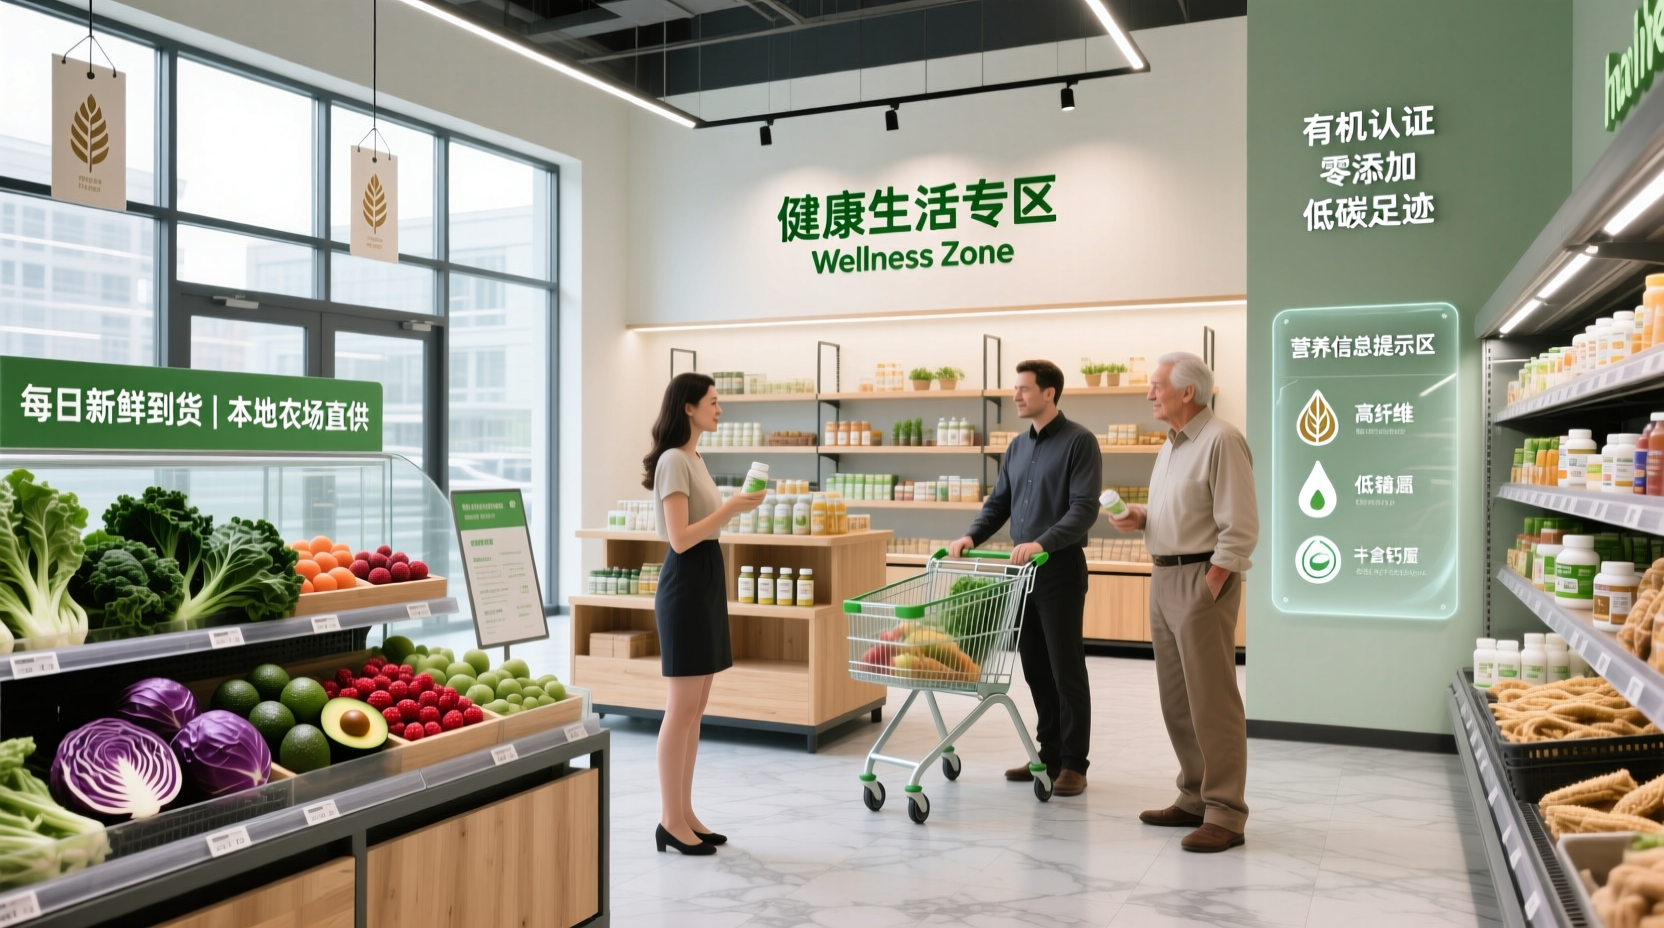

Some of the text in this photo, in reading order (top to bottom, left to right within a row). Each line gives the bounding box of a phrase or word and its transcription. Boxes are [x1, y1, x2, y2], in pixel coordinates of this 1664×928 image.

[1302, 105, 1435, 147] 有机认证
[1319, 150, 1416, 187] 零添加
[777, 174, 1057, 243] 健康生活专区
[1302, 191, 1435, 232] 低碳足迹
[811, 240, 1015, 274] Wellness Zone
[1290, 333, 1436, 359] 营养信息提示区
[20, 383, 203, 427] 每日新鲜到货
[227, 395, 370, 433] 本地农场直供
[1354, 401, 1415, 425] 高纤维
